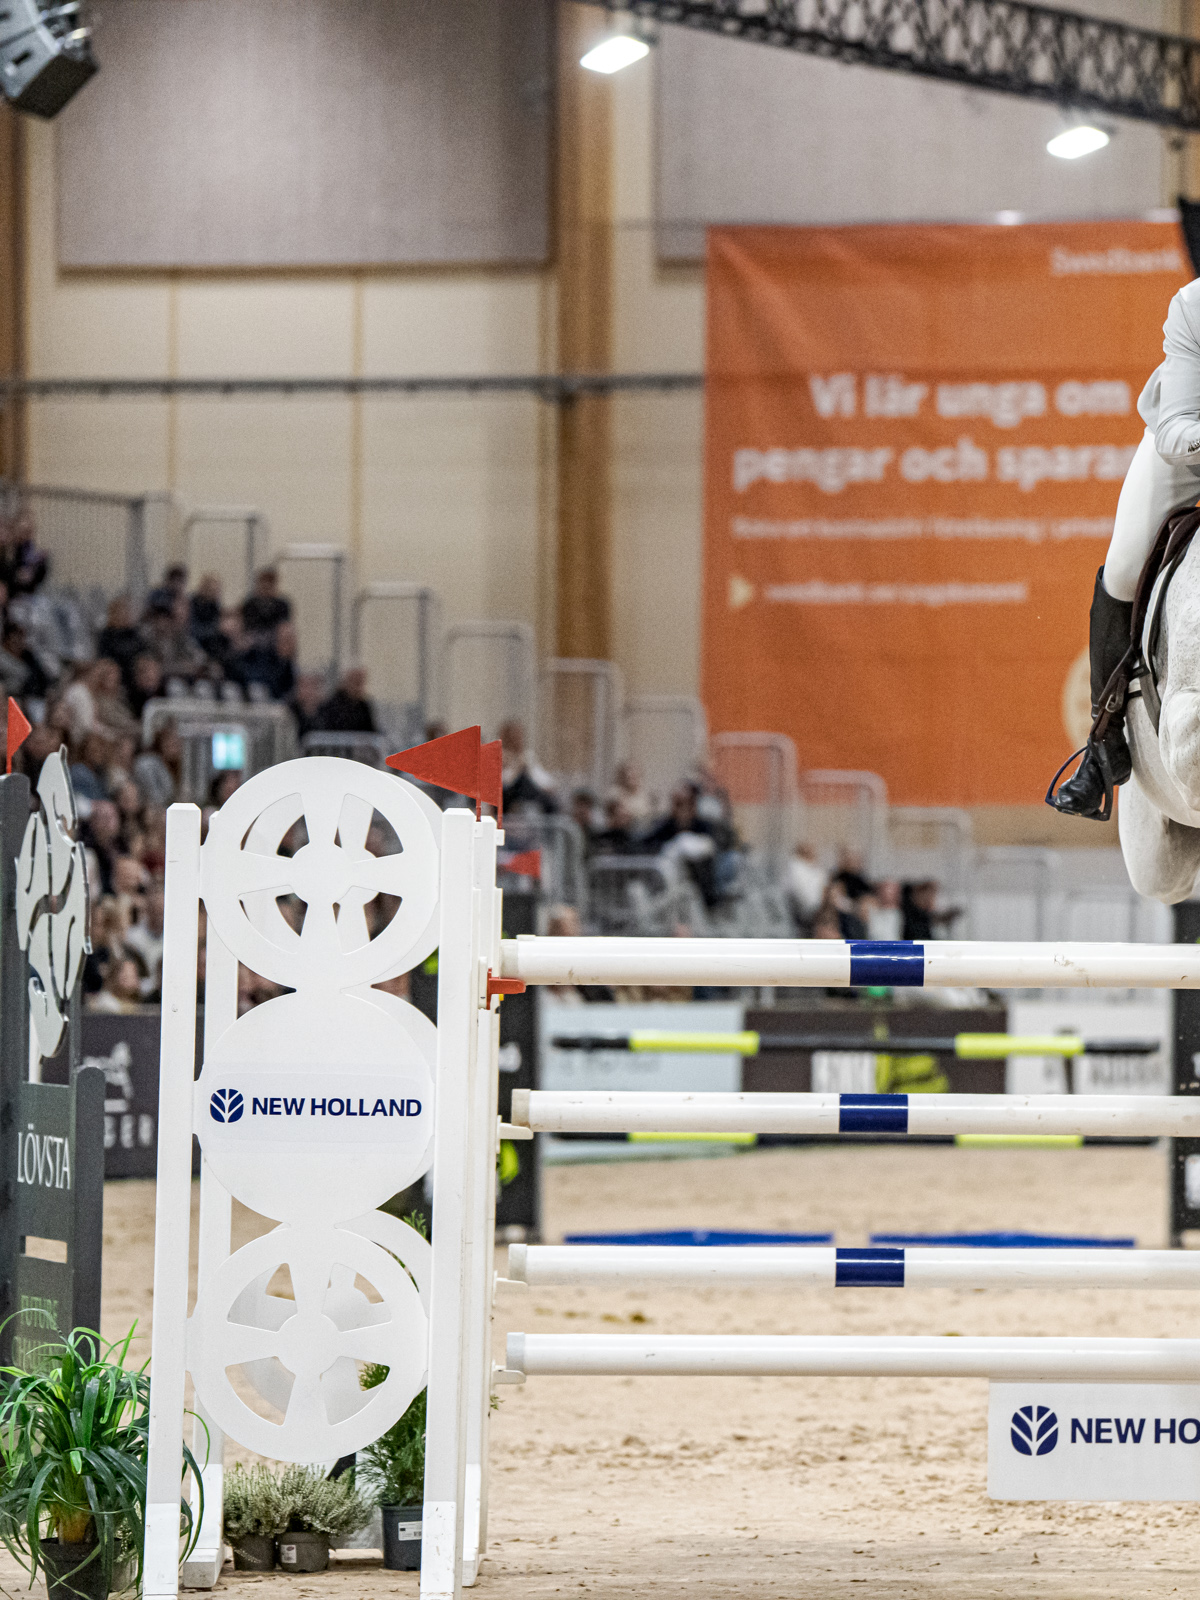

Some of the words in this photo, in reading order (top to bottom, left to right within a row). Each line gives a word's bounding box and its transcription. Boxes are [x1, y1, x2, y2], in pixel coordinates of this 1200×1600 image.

[810, 373, 857, 417] Vi
[865, 374, 928, 417] lär
[937, 383, 1046, 427] unga
[1054, 381, 1131, 416] om
[734, 446, 892, 492] pengar
[901, 436, 987, 481] och
[251, 1097, 306, 1116] NEW
[310, 1097, 422, 1117] HOLLAND
[17, 1124, 71, 1190] LÖVSTA
[1070, 1418, 1147, 1444] NEW
